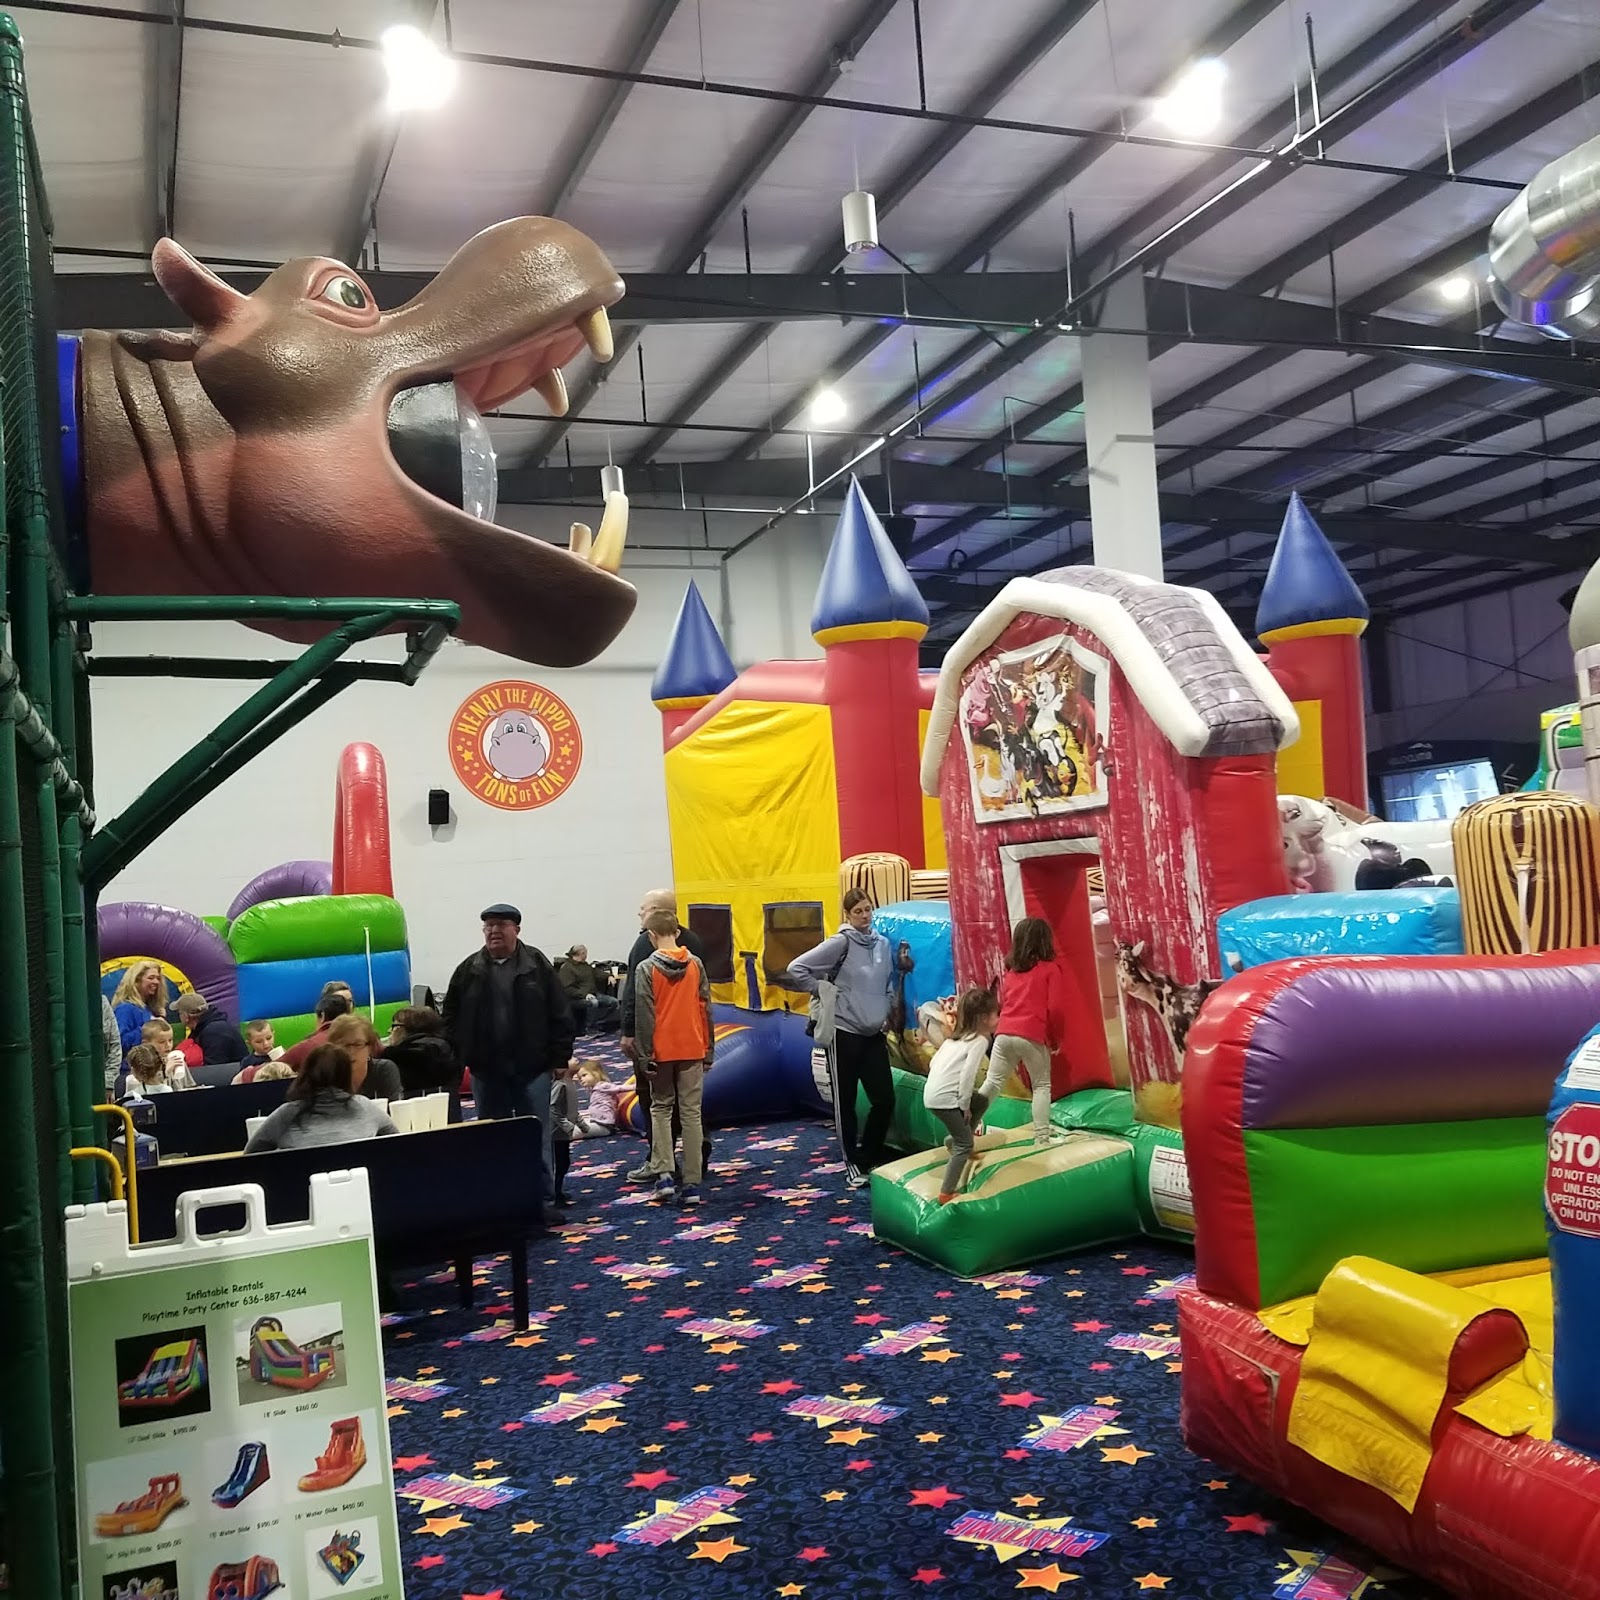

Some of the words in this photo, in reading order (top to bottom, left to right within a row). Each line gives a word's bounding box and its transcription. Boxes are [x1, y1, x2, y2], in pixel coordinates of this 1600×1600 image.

[457, 689, 503, 736] HENRY
[504, 688, 527, 704] THE
[528, 691, 571, 732] HIPPO
[475, 772, 517, 804] TONS
[520, 789, 532, 803] OF
[531, 769, 566, 800] FUN
[1550, 1131, 1600, 1168] STO
[1551, 1167, 1563, 1179] DO
[1564, 1169, 1586, 1182] NOT
[1559, 1206, 1574, 1219] ON
[142, 1310, 180, 1323] Playtime
[183, 1305, 207, 1316] Party
[210, 1300, 239, 1311] Center
[243, 1287, 307, 1305] 636-887-4244
[186, 1286, 229, 1300] Inflatable
[232, 1280, 264, 1293] Rentals
[944, 1516, 1099, 1557] PLAYTIME
